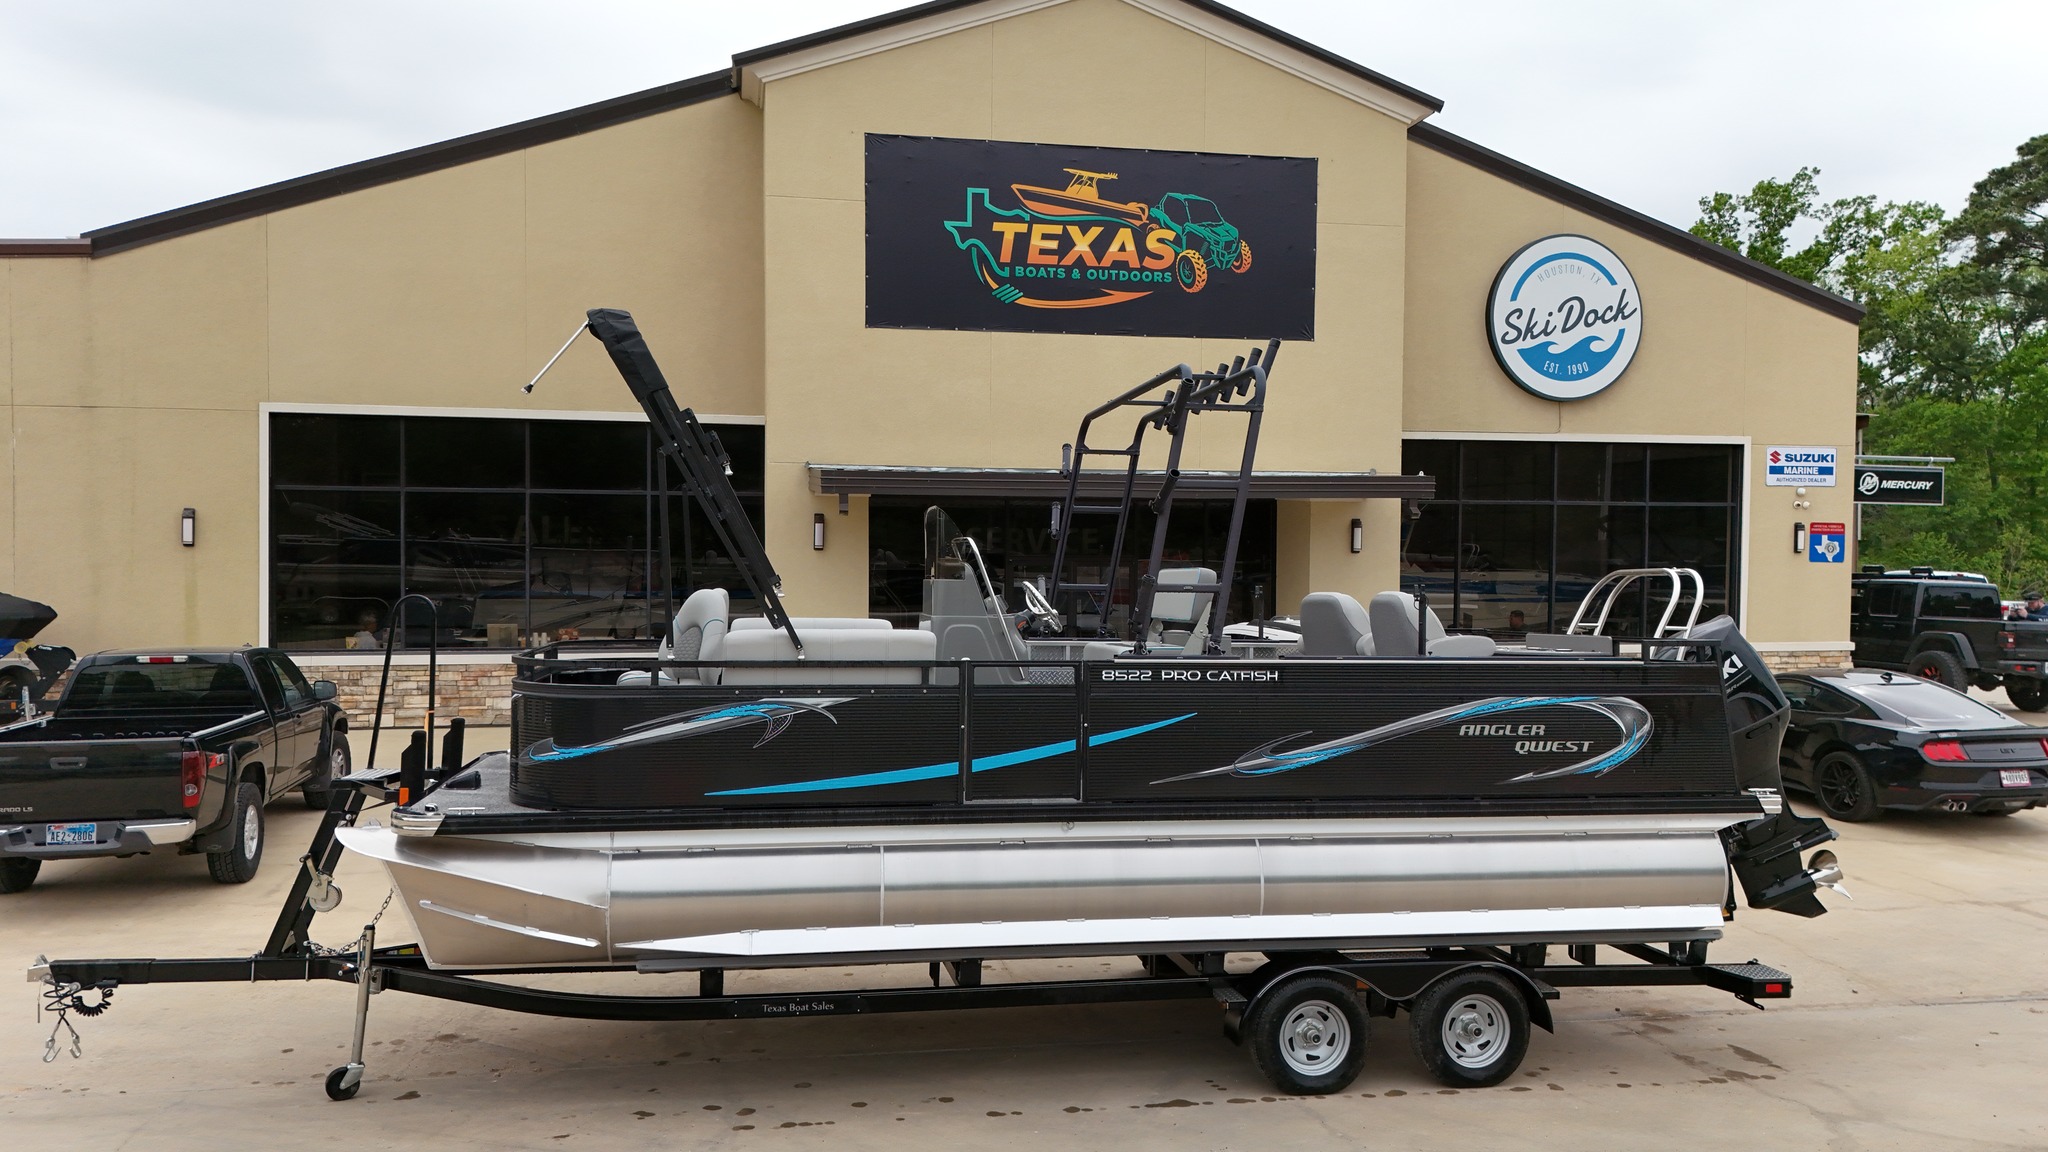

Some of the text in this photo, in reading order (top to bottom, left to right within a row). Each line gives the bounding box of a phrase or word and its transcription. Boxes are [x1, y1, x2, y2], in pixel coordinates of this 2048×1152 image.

[992, 221, 1177, 270] TEXAS
[1014, 266, 1173, 283] BOATS & OUTDOORS
[1537, 264, 1602, 285] HOUSTON, TX
[1543, 360, 1589, 376] EST. 1990
[1784, 453, 1834, 463] SUZUKI
[1783, 466, 1819, 475] MARINE
[1880, 480, 1934, 490] MERCURY
[1101, 669, 1279, 682] 8522 PRO CATFISH
[1459, 724, 1546, 736] ANGLER
[1514, 740, 1595, 755] QWEST
[762, 1001, 835, 1013] Texas Boat Sales
